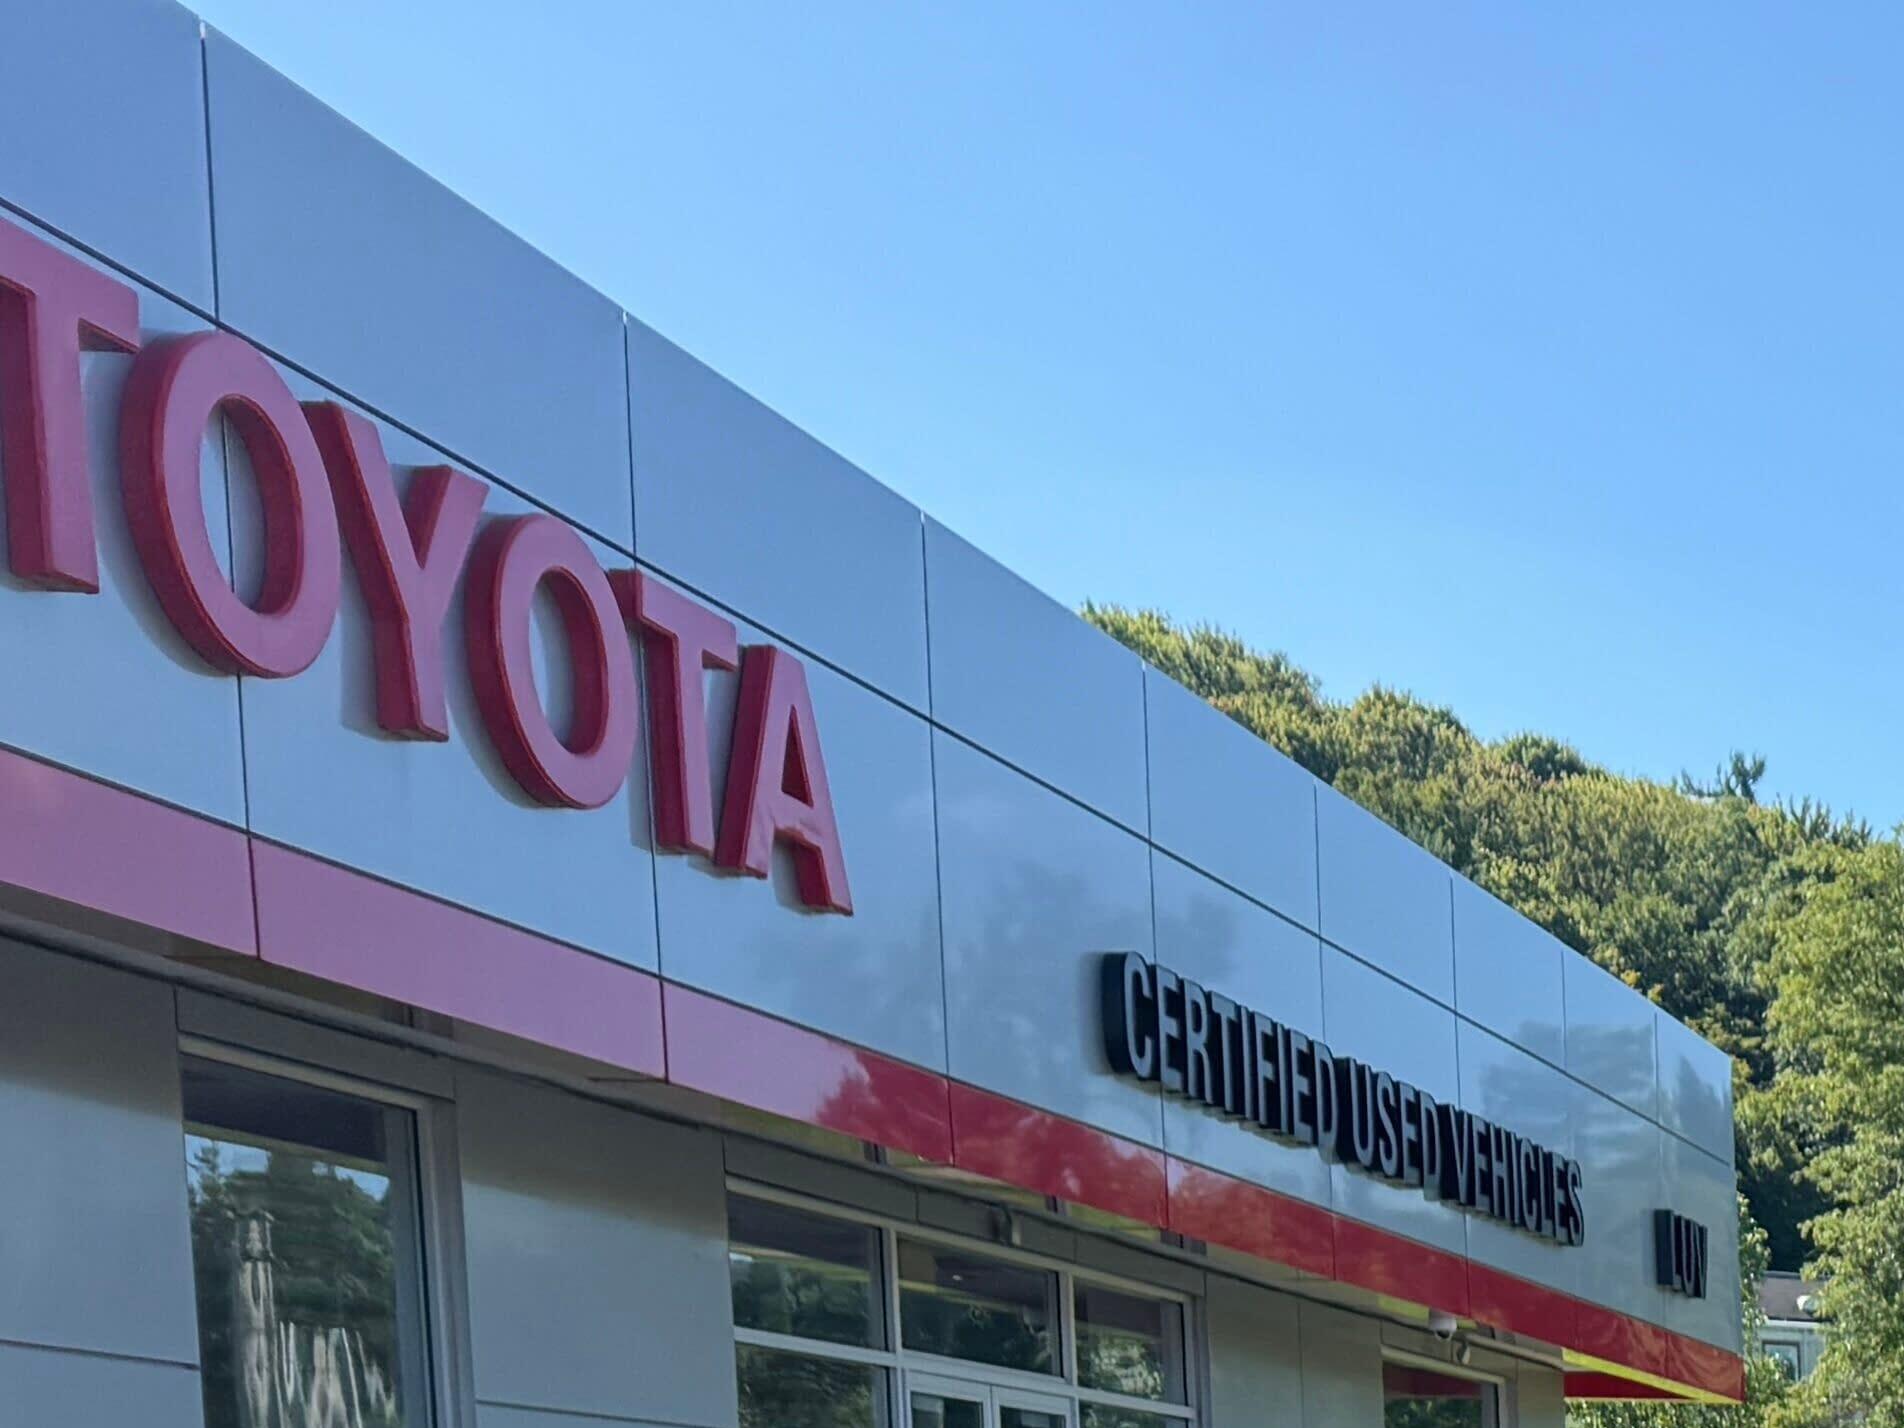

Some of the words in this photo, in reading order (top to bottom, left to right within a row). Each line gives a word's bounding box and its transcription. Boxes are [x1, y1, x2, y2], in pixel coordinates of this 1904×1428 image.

[0, 216, 853, 916] TOYOTA
[1104, 951, 1338, 1154] CERTIFIED
[1344, 1056, 1441, 1198] USED
[1447, 1104, 1584, 1246] VEHICLES
